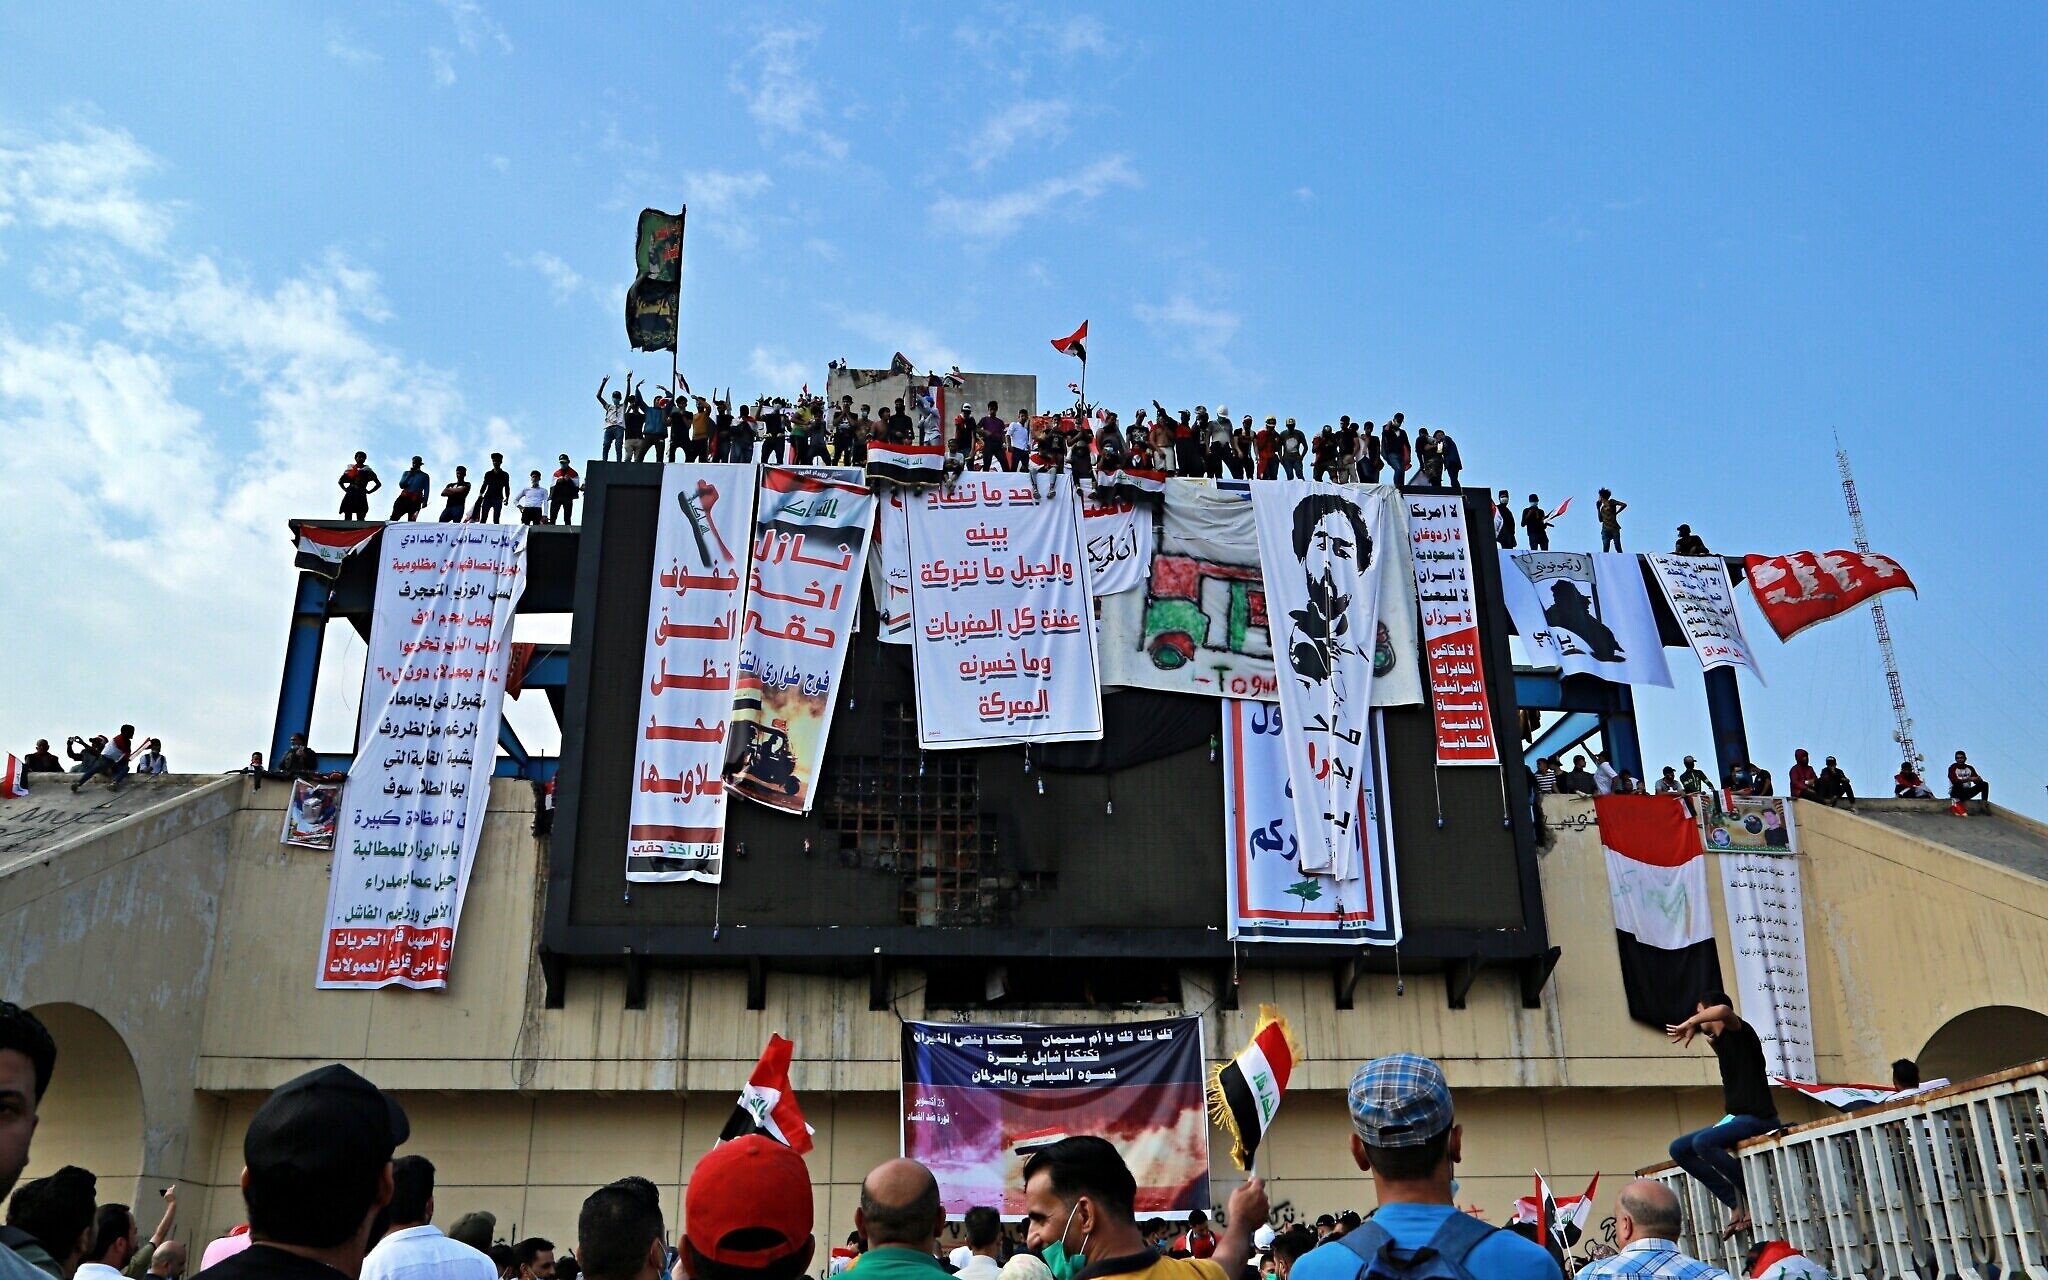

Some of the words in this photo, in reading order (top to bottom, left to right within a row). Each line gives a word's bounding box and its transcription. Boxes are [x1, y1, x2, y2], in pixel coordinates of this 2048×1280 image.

[982, 481, 1002, 503] ما
[1410, 503, 1447, 520] امريكا
[1449, 503, 1458, 518] لا
[966, 522, 1008, 547] بينه
[1412, 527, 1451, 543] اردوغان
[1453, 527, 1462, 540] لا
[752, 529, 852, 571] نازل
[1415, 547, 1455, 563] سعودية
[1457, 547, 1465, 561] لا
[983, 558, 1004, 581] ما
[1011, 554, 1073, 584] والجبل
[1418, 567, 1456, 583] ايران
[1458, 567, 1466, 581] لا
[1420, 588, 1458, 605] للبعث
[1460, 588, 1469, 602] لا
[1007, 607, 1036, 636] كل
[1464, 608, 1472, 622] لا
[654, 606, 737, 646] الحق
[1467, 644, 1474, 656] لا
[1021, 648, 1052, 677] وما
[1435, 662, 1475, 677] المخابرات
[651, 657, 731, 696] تظل
[804, 668, 830, 696] فوج
[978, 689, 1049, 720] المعركة
[646, 714, 726, 745] محد
[1440, 716, 1484, 732] المدنية
[1439, 735, 1491, 751] الكاذبة
[383, 776, 414, 799] سوف
[640, 760, 723, 804] يلاويها
[353, 809, 401, 830] كبيرة
[353, 840, 407, 861] للمطالبة
[632, 842, 664, 856] حقي
[667, 842, 691, 856] اخذ
[695, 844, 719, 859] نازل
[335, 930, 388, 951] الحريات
[329, 956, 386, 976] العمولات
[913, 1031, 951, 1046] النيران
[954, 1034, 984, 1048] بنص
[1041, 1033, 1086, 1048] سليمان
[1088, 1030, 1102, 1047] أم
[1104, 1032, 1114, 1046] يا
[1117, 1030, 1134, 1042] تك
[1137, 1029, 1153, 1041] تك
[1156, 1028, 1173, 1040] تك
[987, 1050, 1028, 1066] غيرة
[1032, 1049, 1061, 1066] شايل
[1064, 1048, 1100, 1062] تكتكنا
[971, 1068, 1018, 1084] والبرلمان
[1021, 1068, 1074, 1087] السياسي
[937, 1098, 945, 1108] 25
